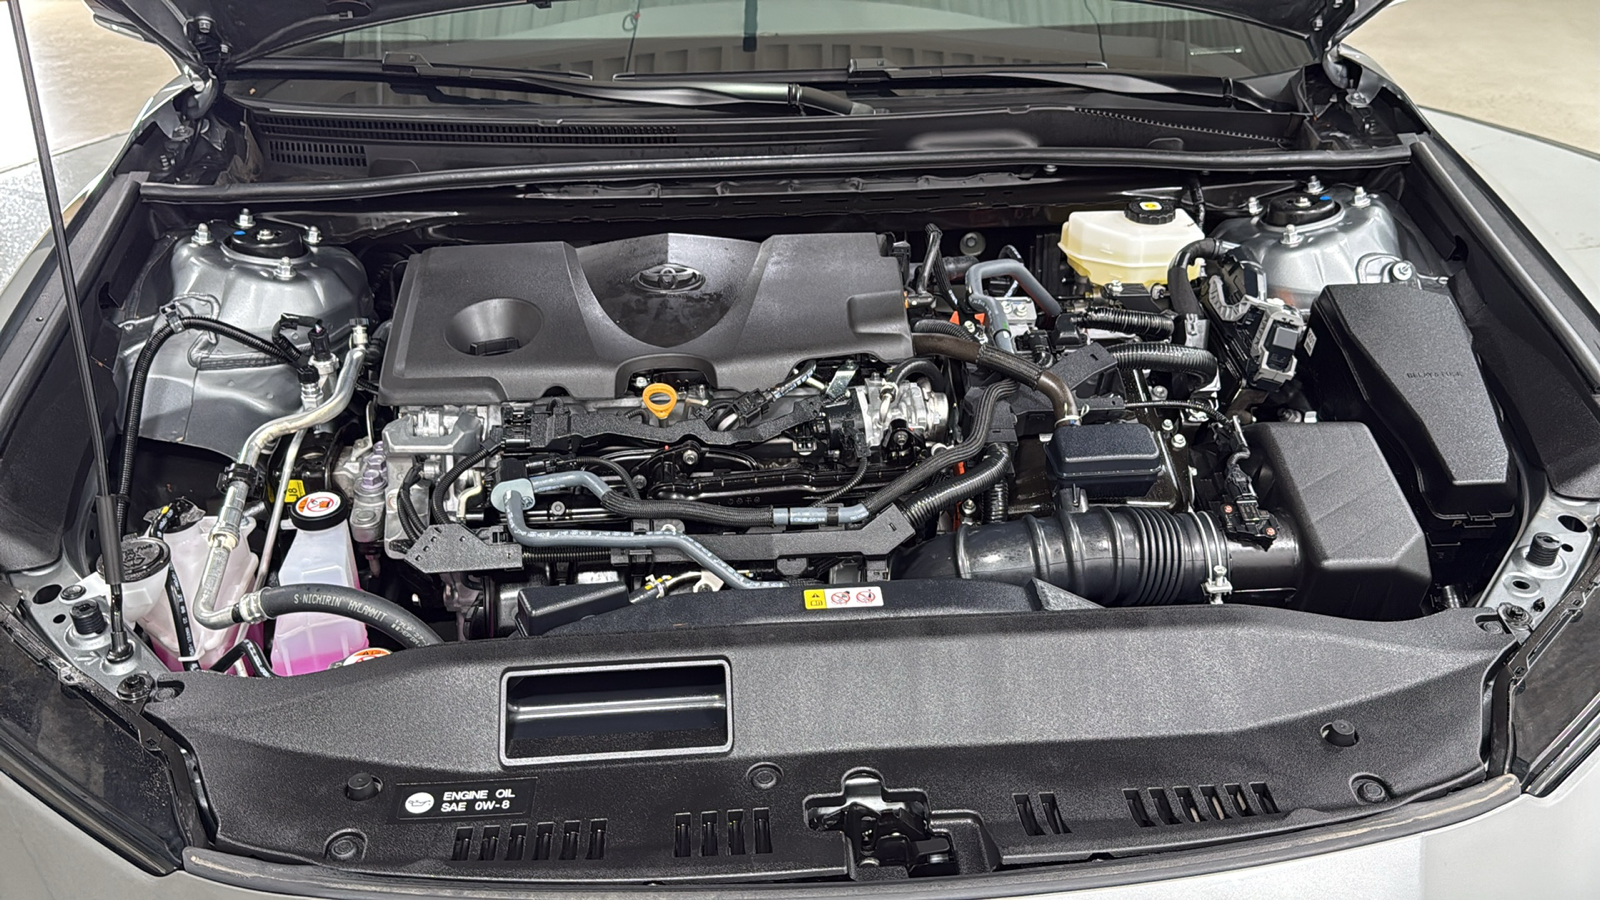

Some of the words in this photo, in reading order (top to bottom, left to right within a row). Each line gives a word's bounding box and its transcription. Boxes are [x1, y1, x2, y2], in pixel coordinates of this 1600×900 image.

[443, 790, 489, 801] ENGINE
[495, 788, 515, 798] OIL
[440, 802, 467, 812] SAE
